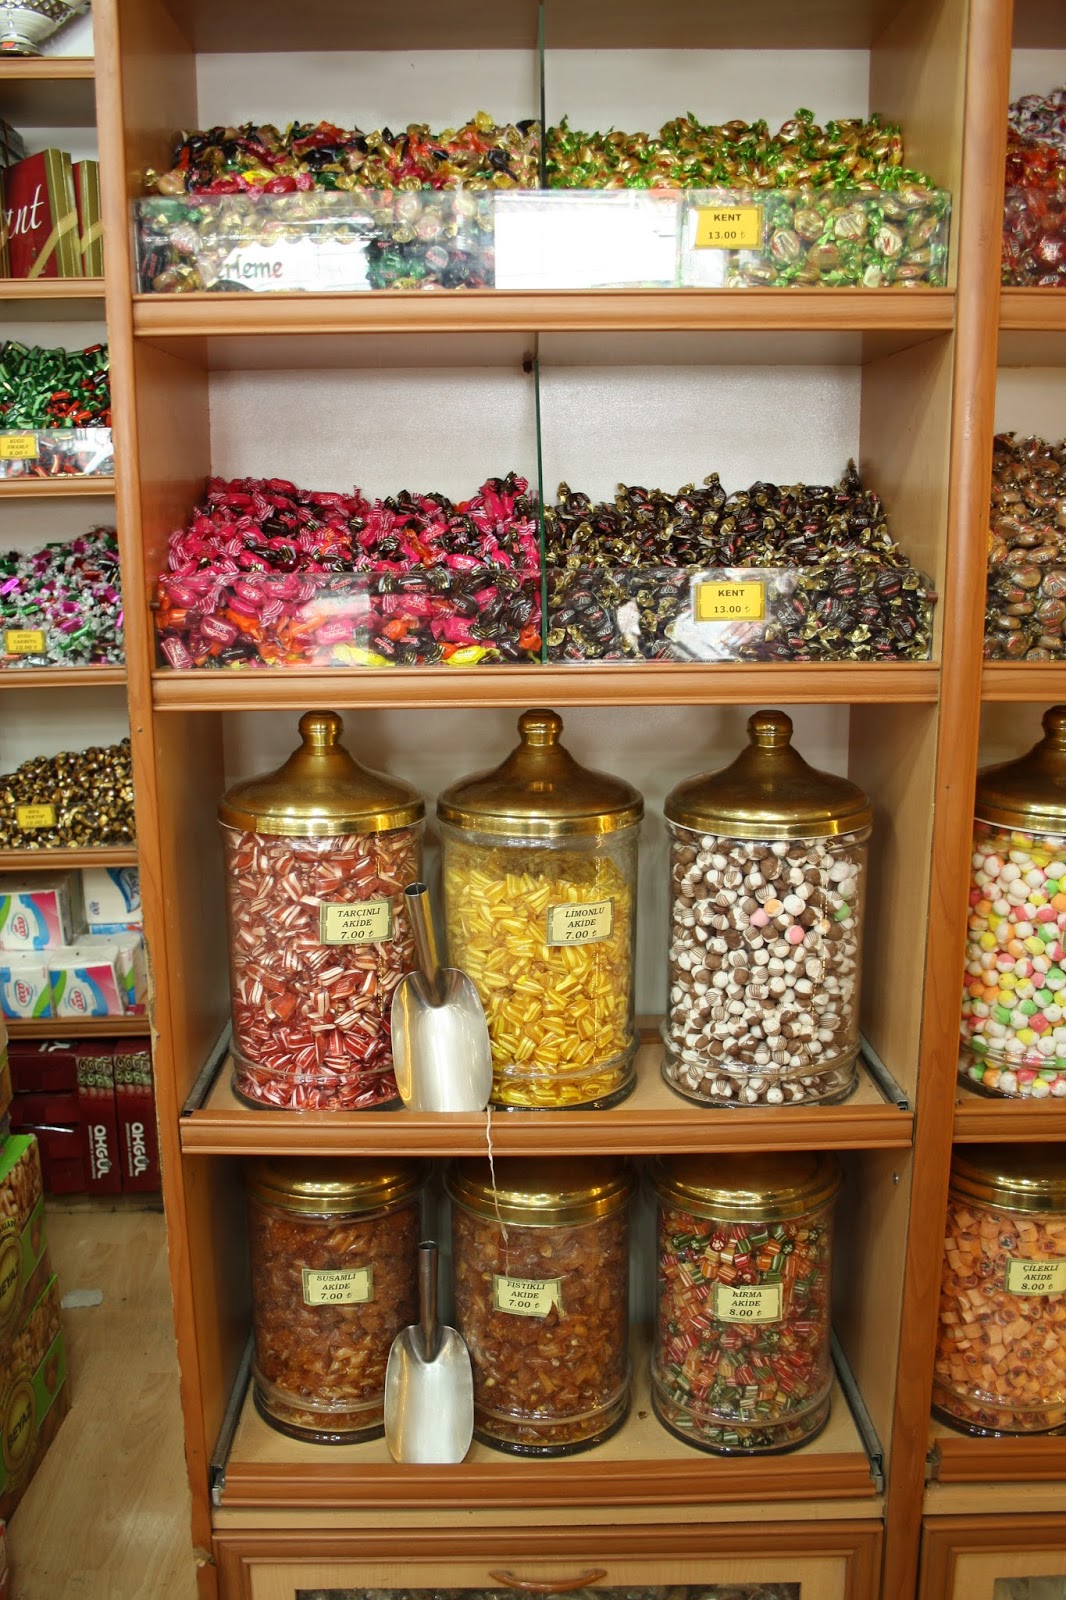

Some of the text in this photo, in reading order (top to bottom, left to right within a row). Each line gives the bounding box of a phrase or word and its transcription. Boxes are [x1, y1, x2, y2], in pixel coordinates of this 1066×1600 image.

[713, 213, 742, 222] KENT
[708, 231, 737, 240] 13.00
[718, 589, 746, 597] KENT
[713, 605, 742, 613] 13.00
[565, 907, 605, 918] LİMONLU
[340, 930, 365, 940] 7.00
[565, 930, 589, 940] 7.00
[316, 1273, 356, 1282] SUSAMLI
[320, 1292, 343, 1300] 7.00
[508, 1299, 531, 1308] 7.00
[729, 1308, 753, 1317] 8.00
